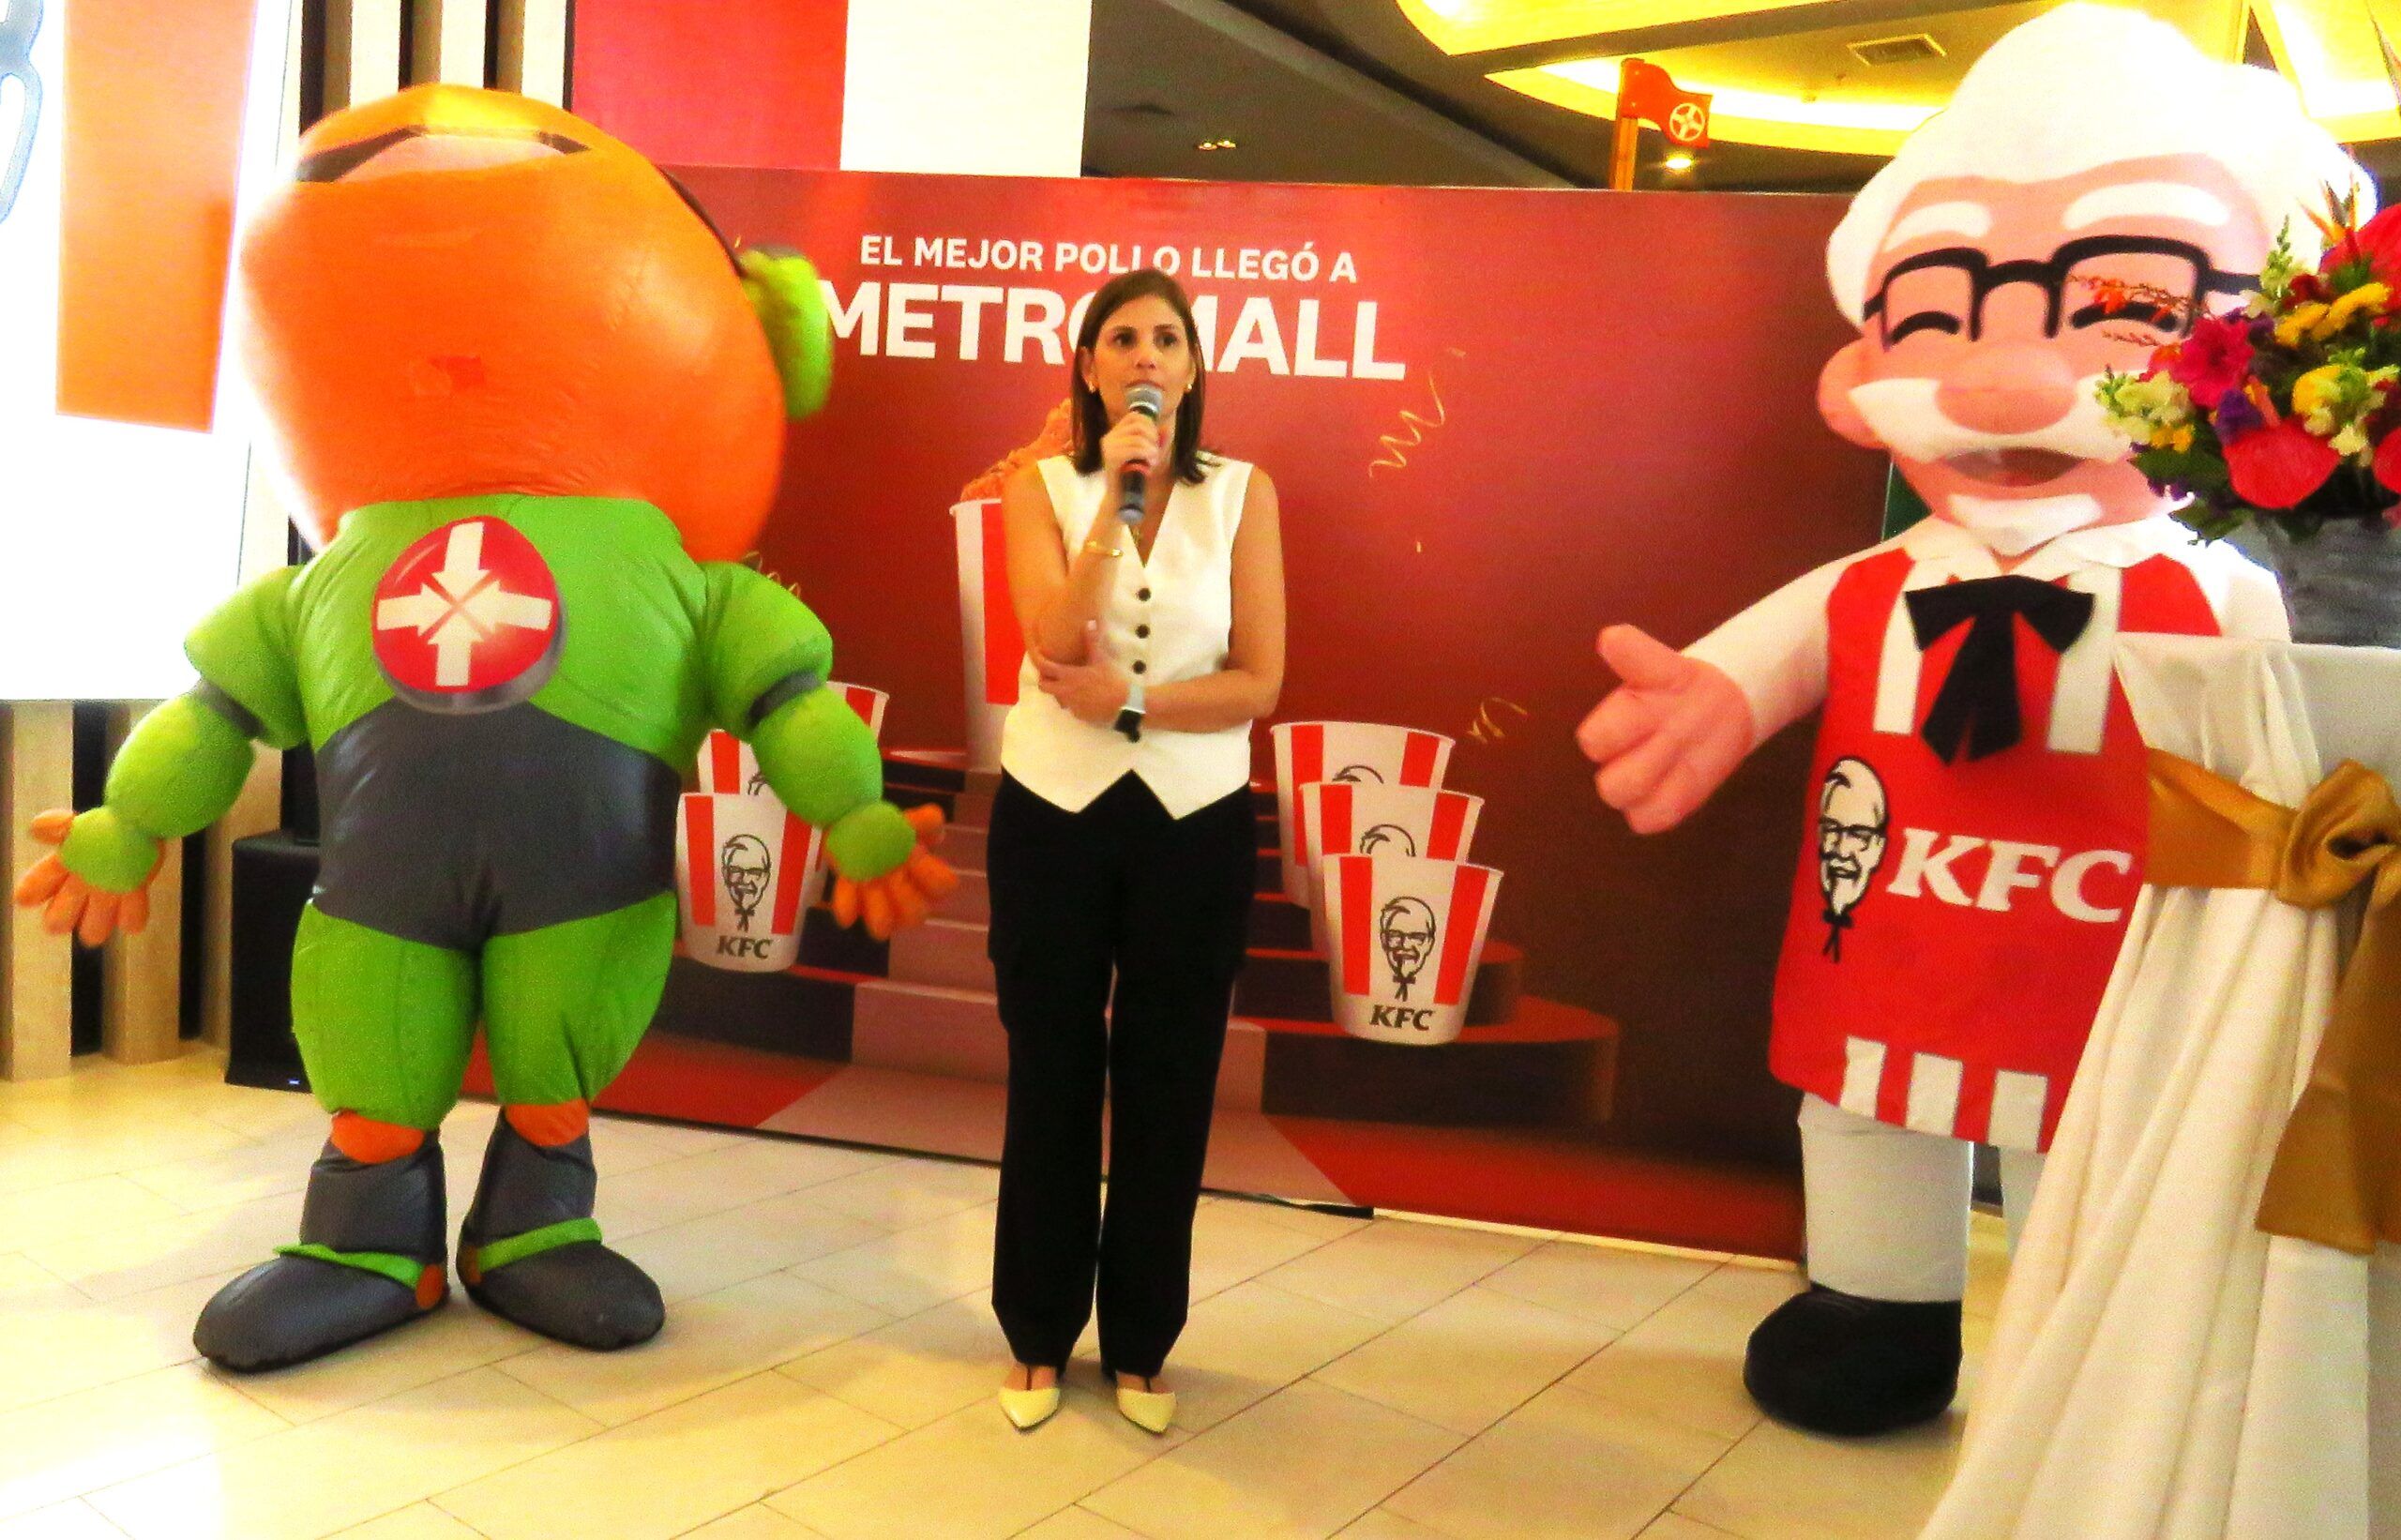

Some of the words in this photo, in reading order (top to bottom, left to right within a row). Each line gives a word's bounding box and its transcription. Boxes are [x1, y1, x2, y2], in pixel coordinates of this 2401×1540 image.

[860, 234, 902, 265] EL
[914, 236, 1044, 271] MEJOR
[1191, 241, 1320, 281] LLEGÓ
[1329, 251, 1357, 283] A
[1886, 827, 2133, 923] KFC
[716, 935, 771, 959] KFC
[1369, 1004, 1435, 1031] KFC
